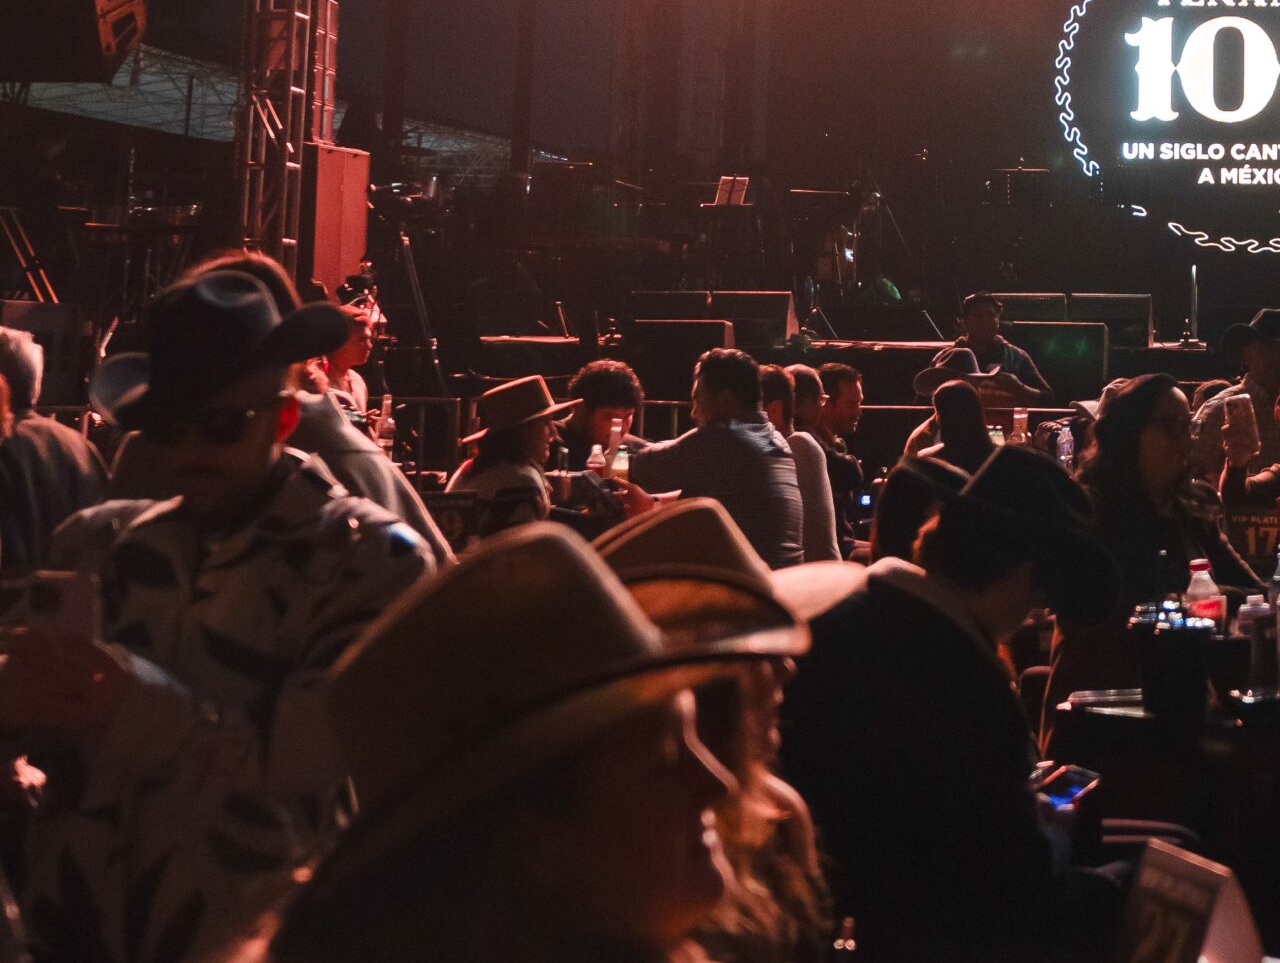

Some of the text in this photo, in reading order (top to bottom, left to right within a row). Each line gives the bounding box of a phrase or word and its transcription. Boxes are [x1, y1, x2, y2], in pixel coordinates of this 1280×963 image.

[1122, 142, 1154, 160] UN
[1159, 142, 1225, 160] SIGLO
[1197, 168, 1215, 185] A
